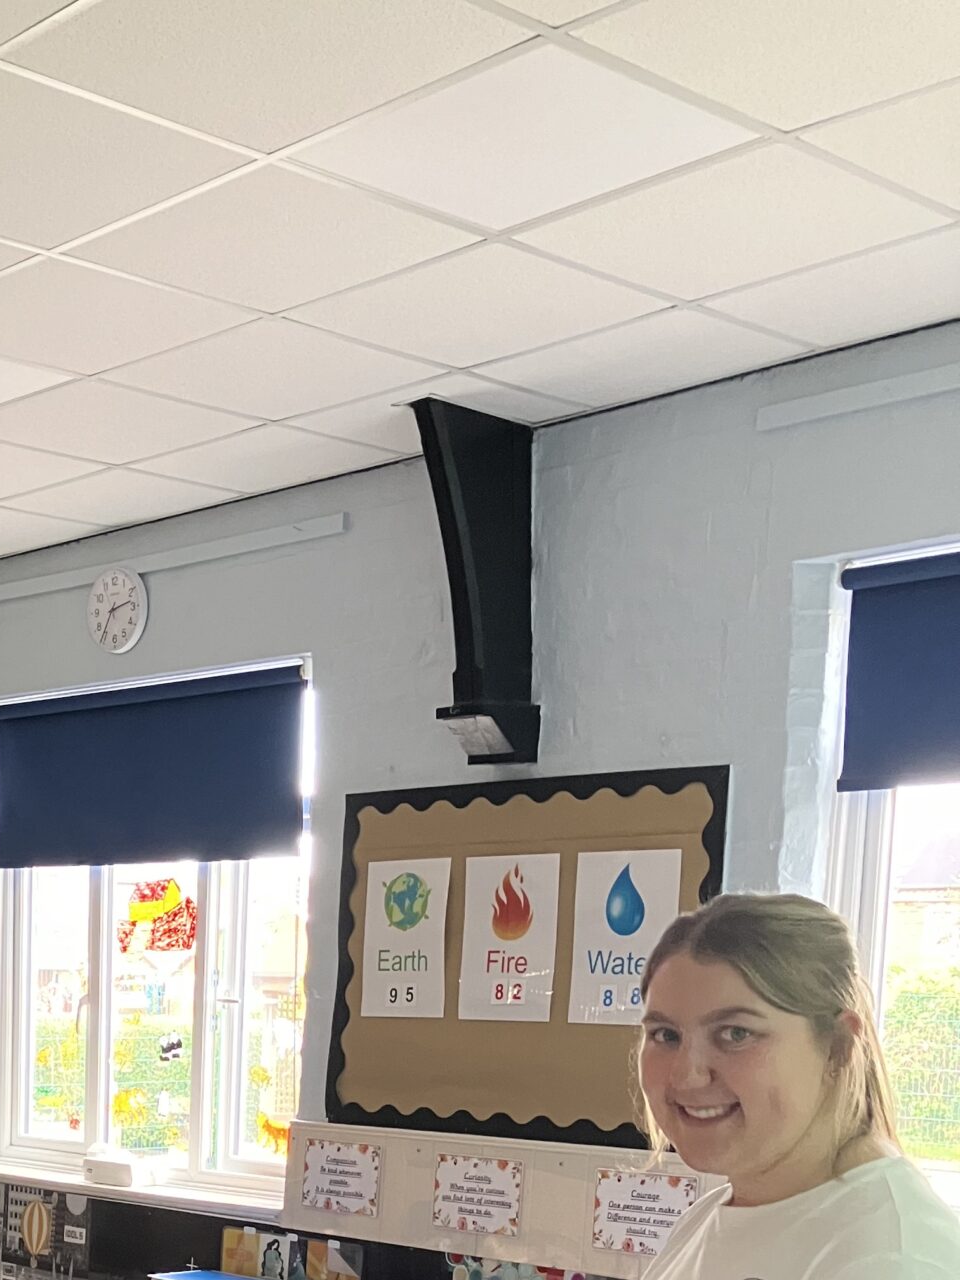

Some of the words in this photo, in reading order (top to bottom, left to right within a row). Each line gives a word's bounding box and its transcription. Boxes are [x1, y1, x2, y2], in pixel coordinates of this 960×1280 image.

[111, 576, 119, 586] 12
[128, 586, 134, 598] 2
[96, 593, 104, 604] 10
[130, 601, 136, 611] 3
[94, 608, 100, 618] 9
[96, 622, 102, 632] 8
[112, 634, 118, 644] 6
[378, 949, 428, 972] Earth
[486, 950, 528, 974] Fire
[587, 950, 647, 975] Wate
[464, 1172, 492, 1185] Curiosity
[449, 1182, 465, 1191] When
[631, 1189, 660, 1202] Courage
[608, 1200, 620, 1209] One
[622, 1203, 643, 1212] person
[658, 1206, 675, 1214] make
[607, 1212, 637, 1223] Difference
[639, 1216, 651, 1224] and
